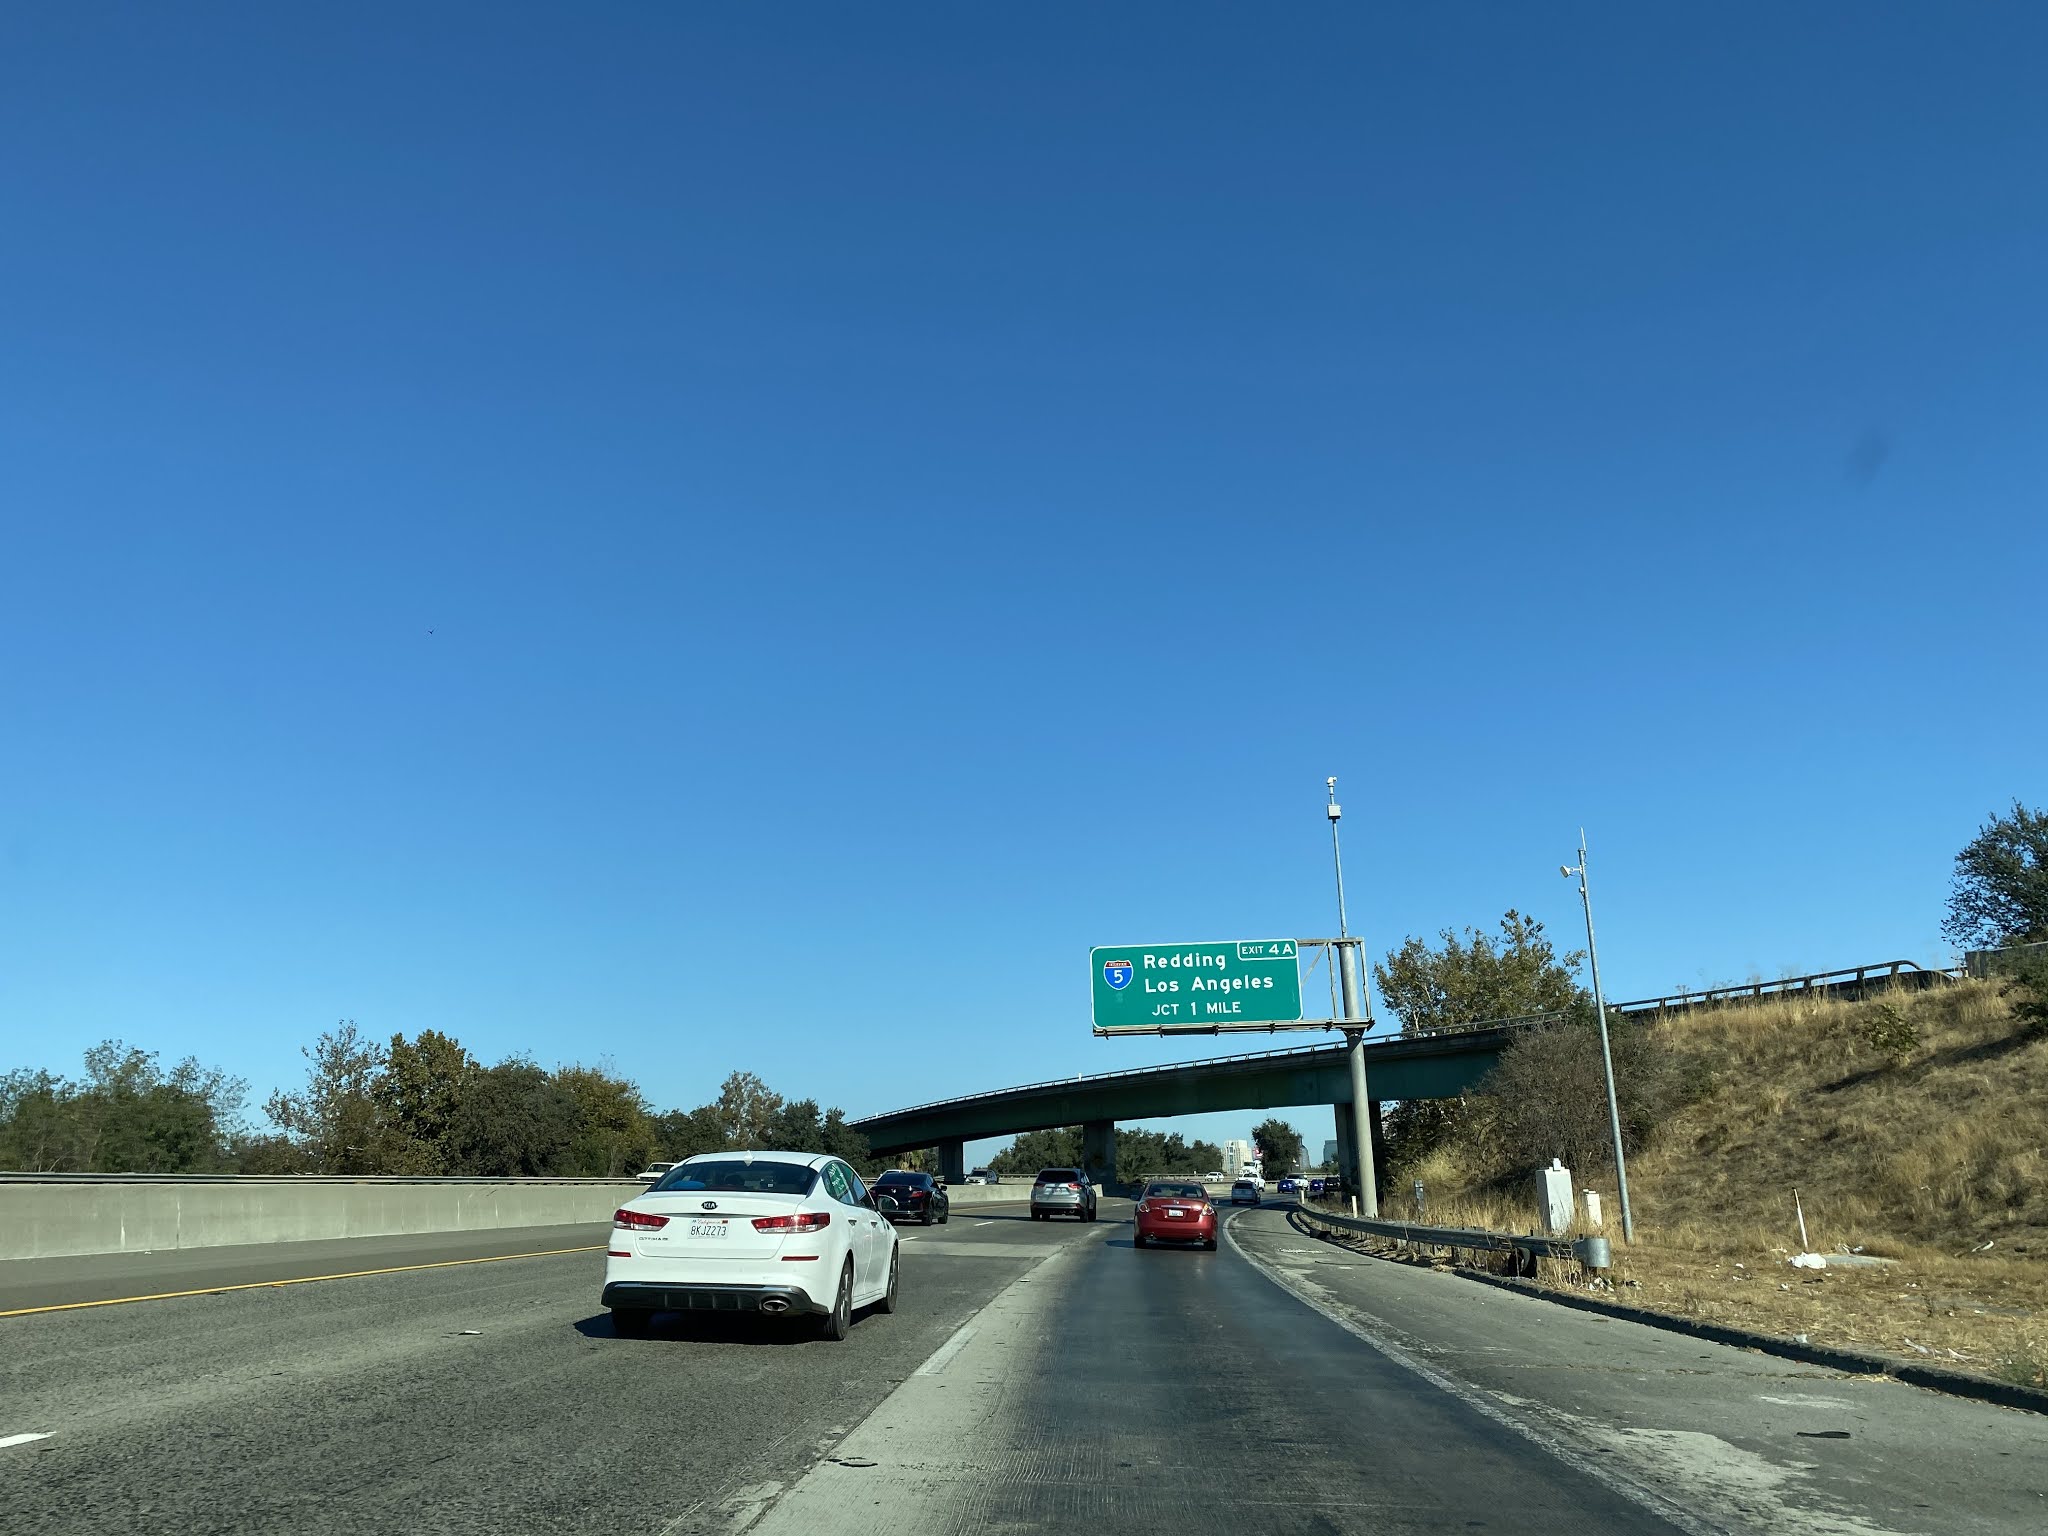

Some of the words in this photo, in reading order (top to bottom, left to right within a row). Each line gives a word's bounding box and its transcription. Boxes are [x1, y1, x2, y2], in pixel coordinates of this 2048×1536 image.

[1242, 945, 1263, 955] EXIT
[1268, 943, 1293, 955] 4A
[1143, 952, 1226, 970] Redding
[1113, 969, 1124, 984] 5
[1144, 978, 1179, 993] Los
[1191, 974, 1274, 994] Angeles
[1151, 1003, 1179, 1016] JCT
[1190, 1002, 1197, 1016] 1
[1206, 1001, 1241, 1014] MILE
[690, 1225, 727, 1236] 8KJZ273
